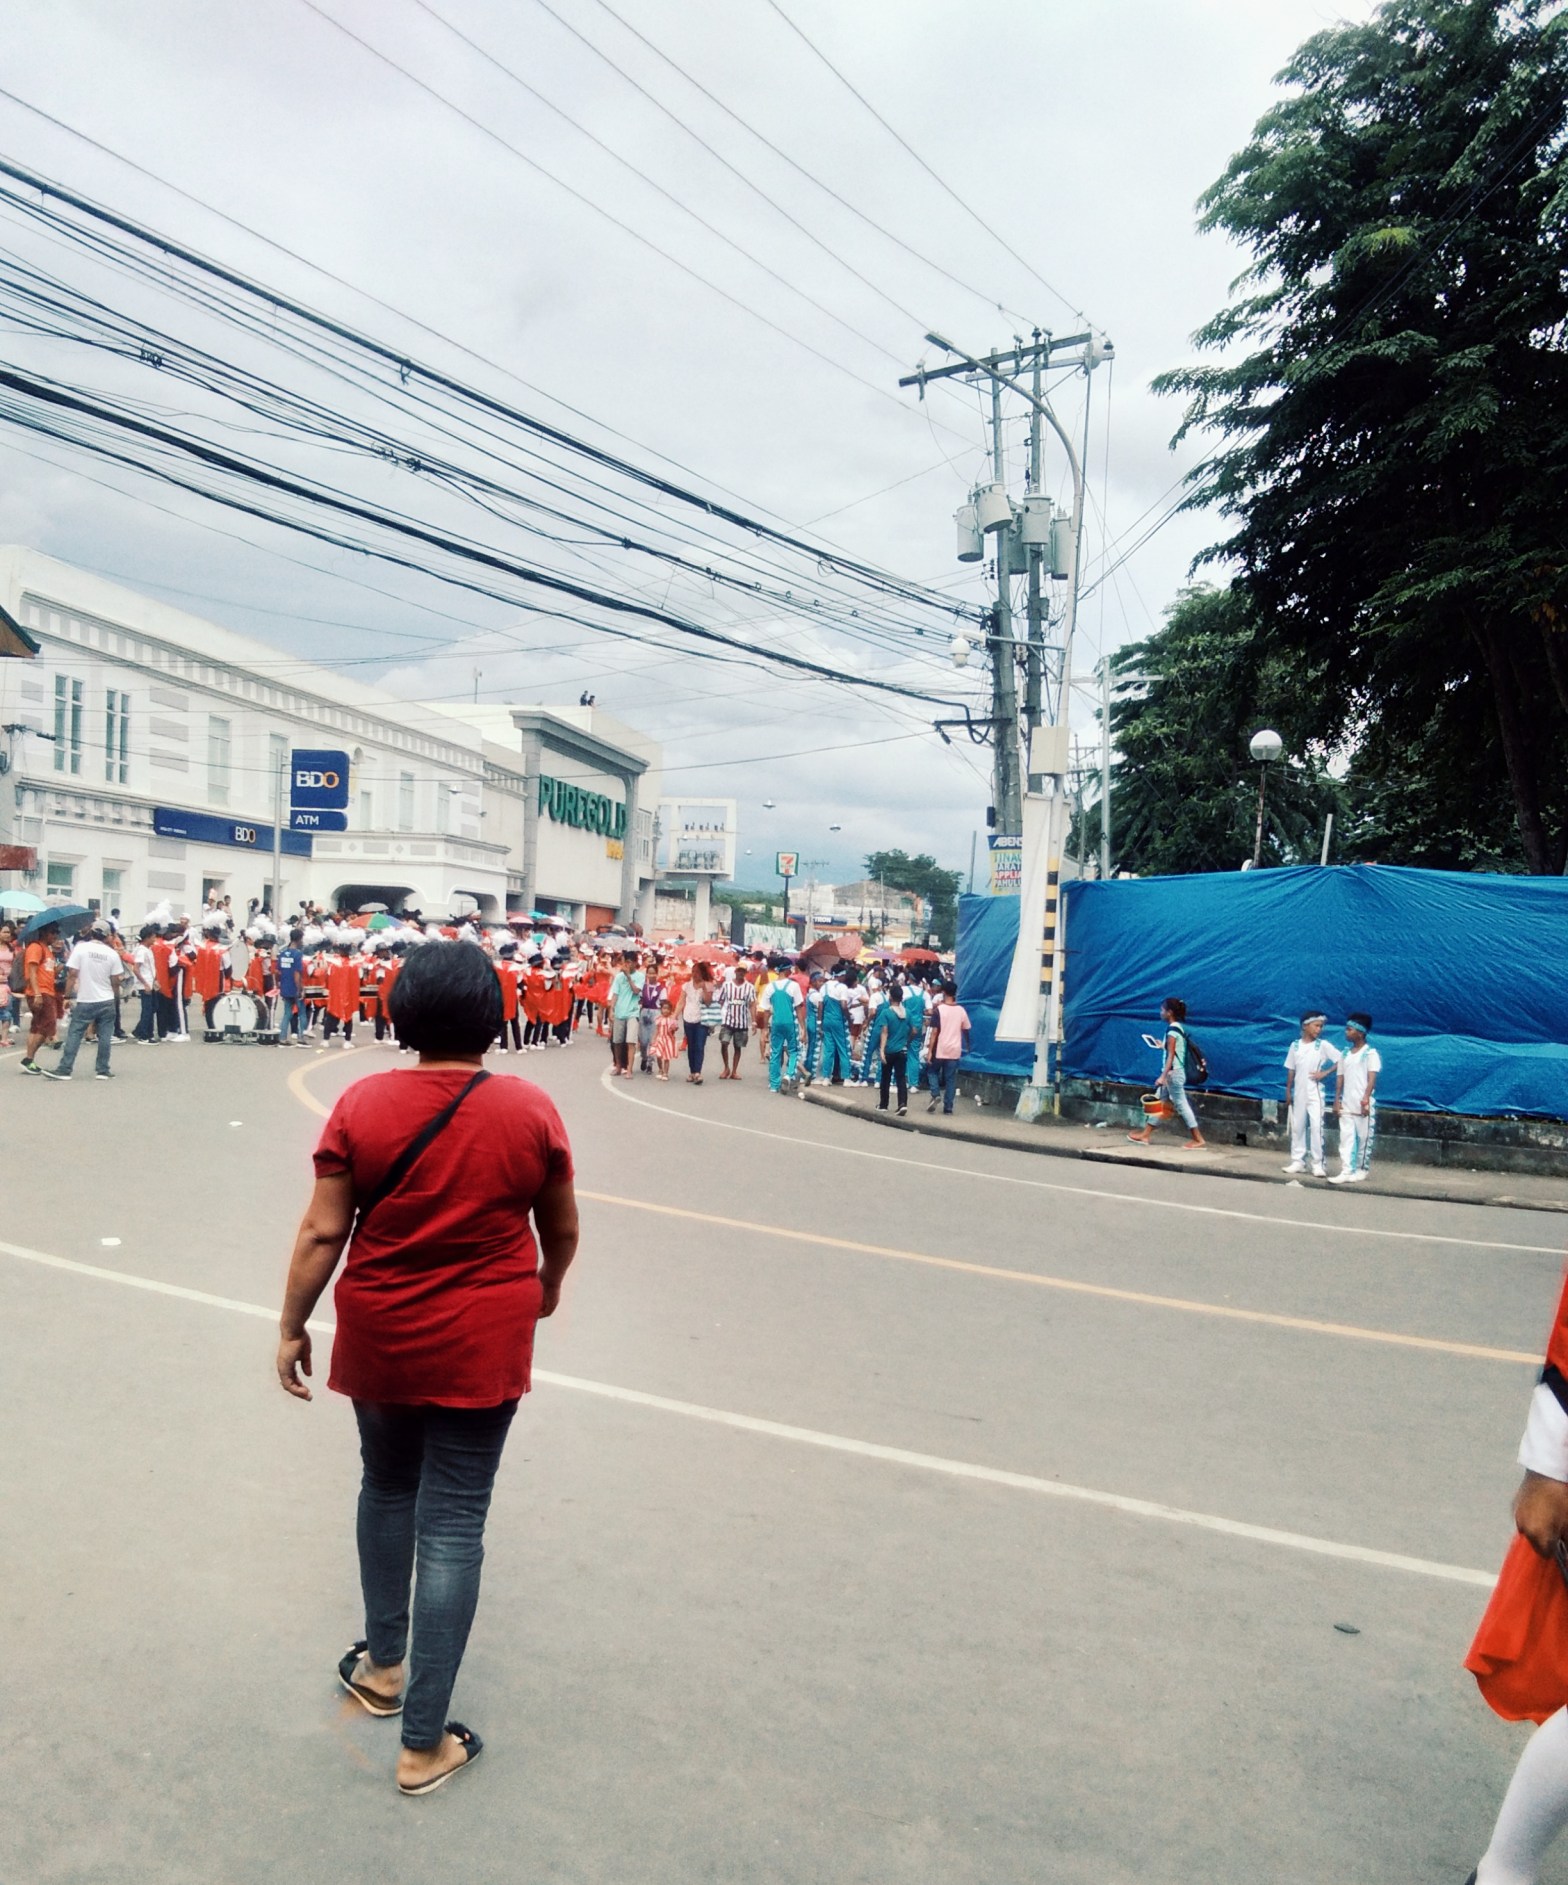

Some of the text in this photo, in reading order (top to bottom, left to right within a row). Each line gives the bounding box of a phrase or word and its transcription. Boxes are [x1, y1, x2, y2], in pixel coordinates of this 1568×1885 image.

[296, 771, 340, 789] BDO
[538, 773, 627, 840] PUREGOLD
[295, 814, 320, 826] ATM
[235, 826, 256, 843] BDO
